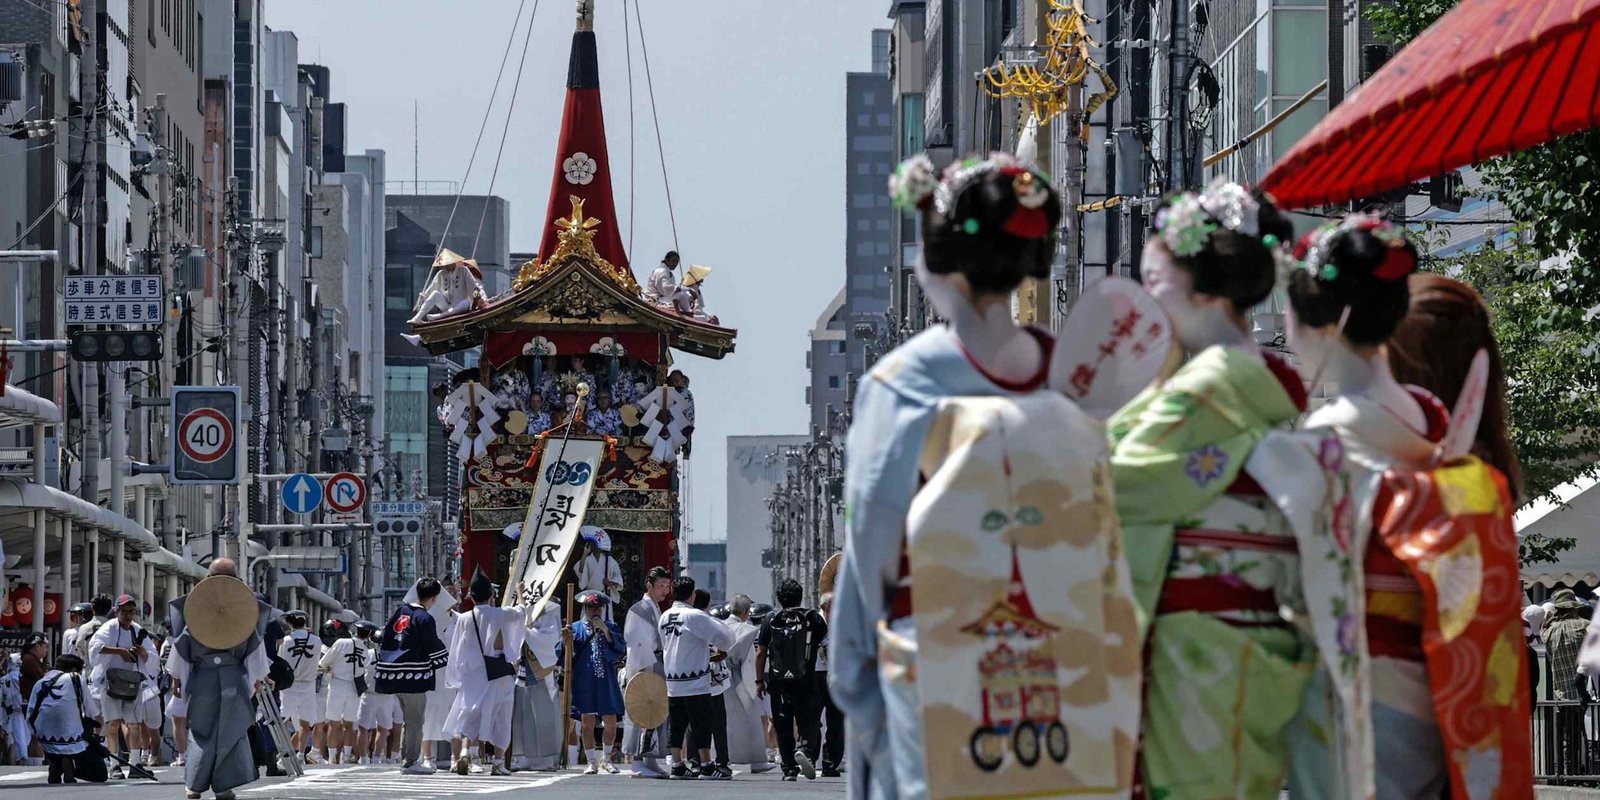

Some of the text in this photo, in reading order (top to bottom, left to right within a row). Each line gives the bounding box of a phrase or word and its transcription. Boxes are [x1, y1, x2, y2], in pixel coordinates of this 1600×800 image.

[67, 280, 158, 296] 歩車分離信号
[68, 304, 158, 320] 時差式信号機
[191, 424, 220, 447] 40
[372, 503, 422, 513] 歩車分離信号
[661, 612, 684, 637] 長
[288, 638, 314, 659] 長
